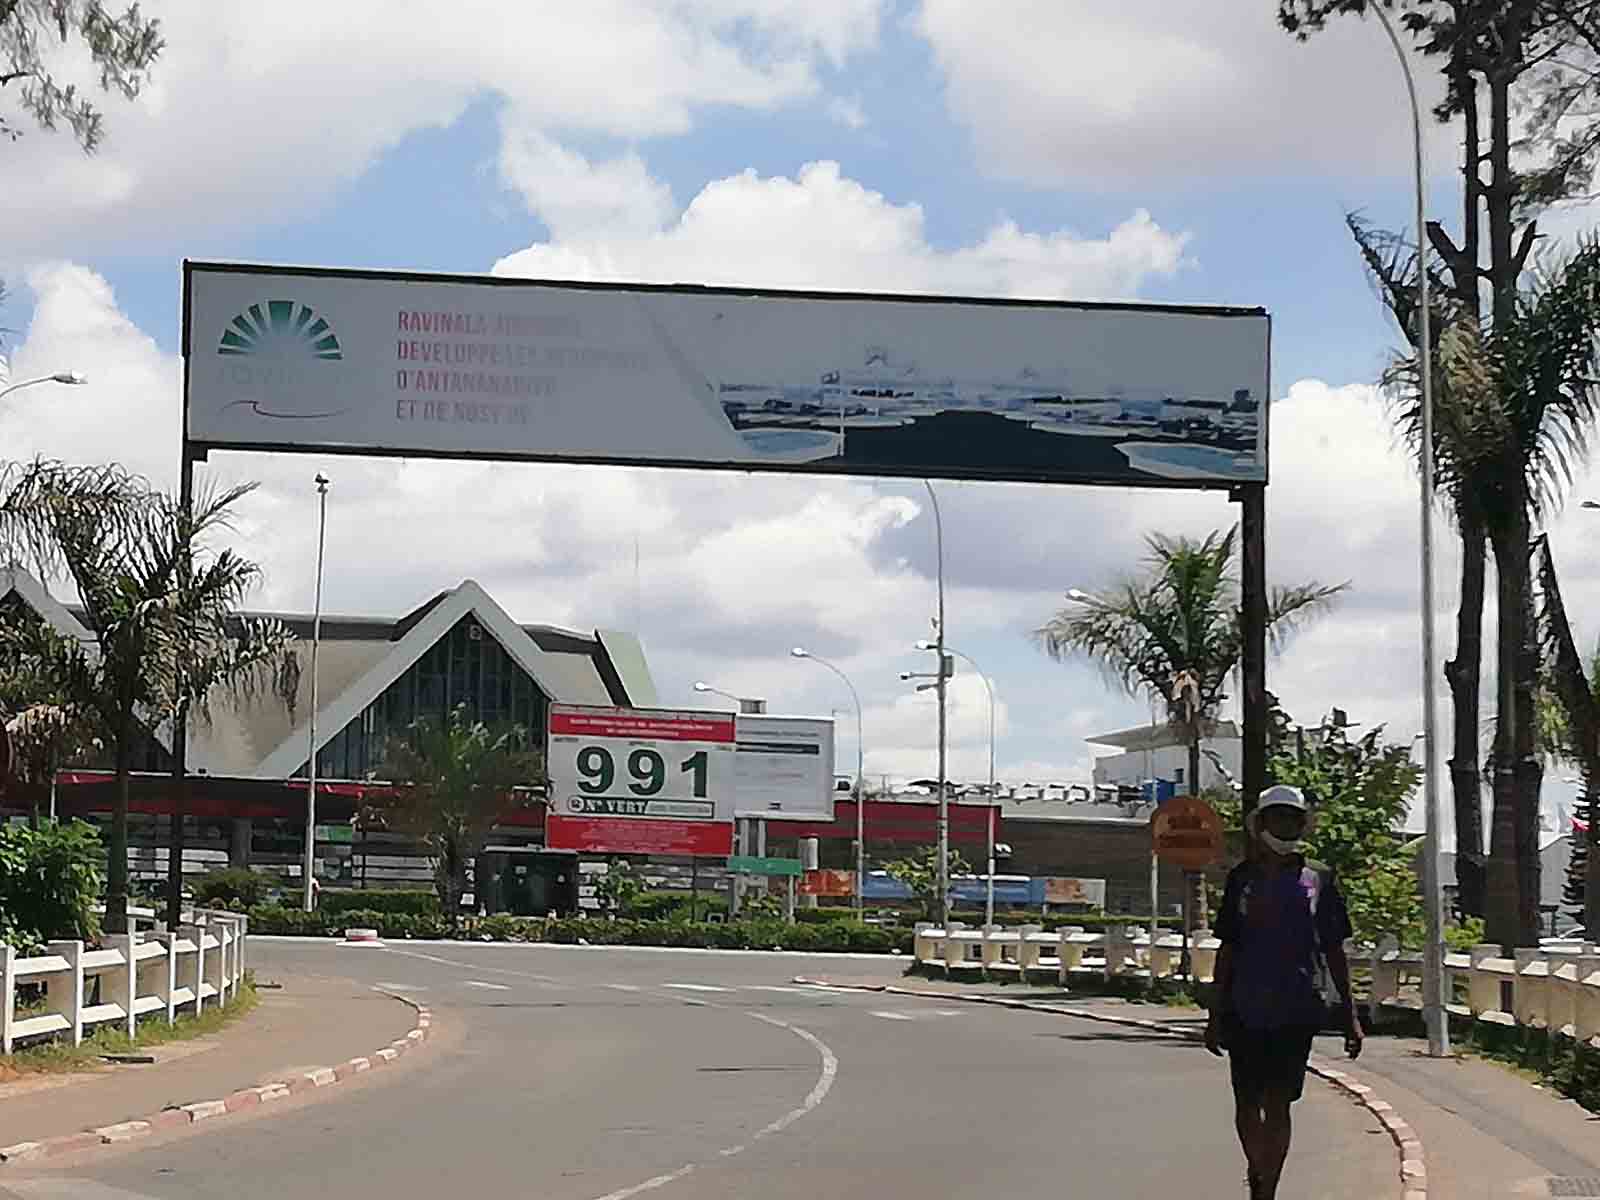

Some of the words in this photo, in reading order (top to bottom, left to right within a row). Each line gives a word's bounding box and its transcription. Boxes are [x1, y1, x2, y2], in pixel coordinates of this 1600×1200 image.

[395, 399, 417, 421] ET
[575, 745, 709, 799] 991
[607, 800, 646, 815] VERT
